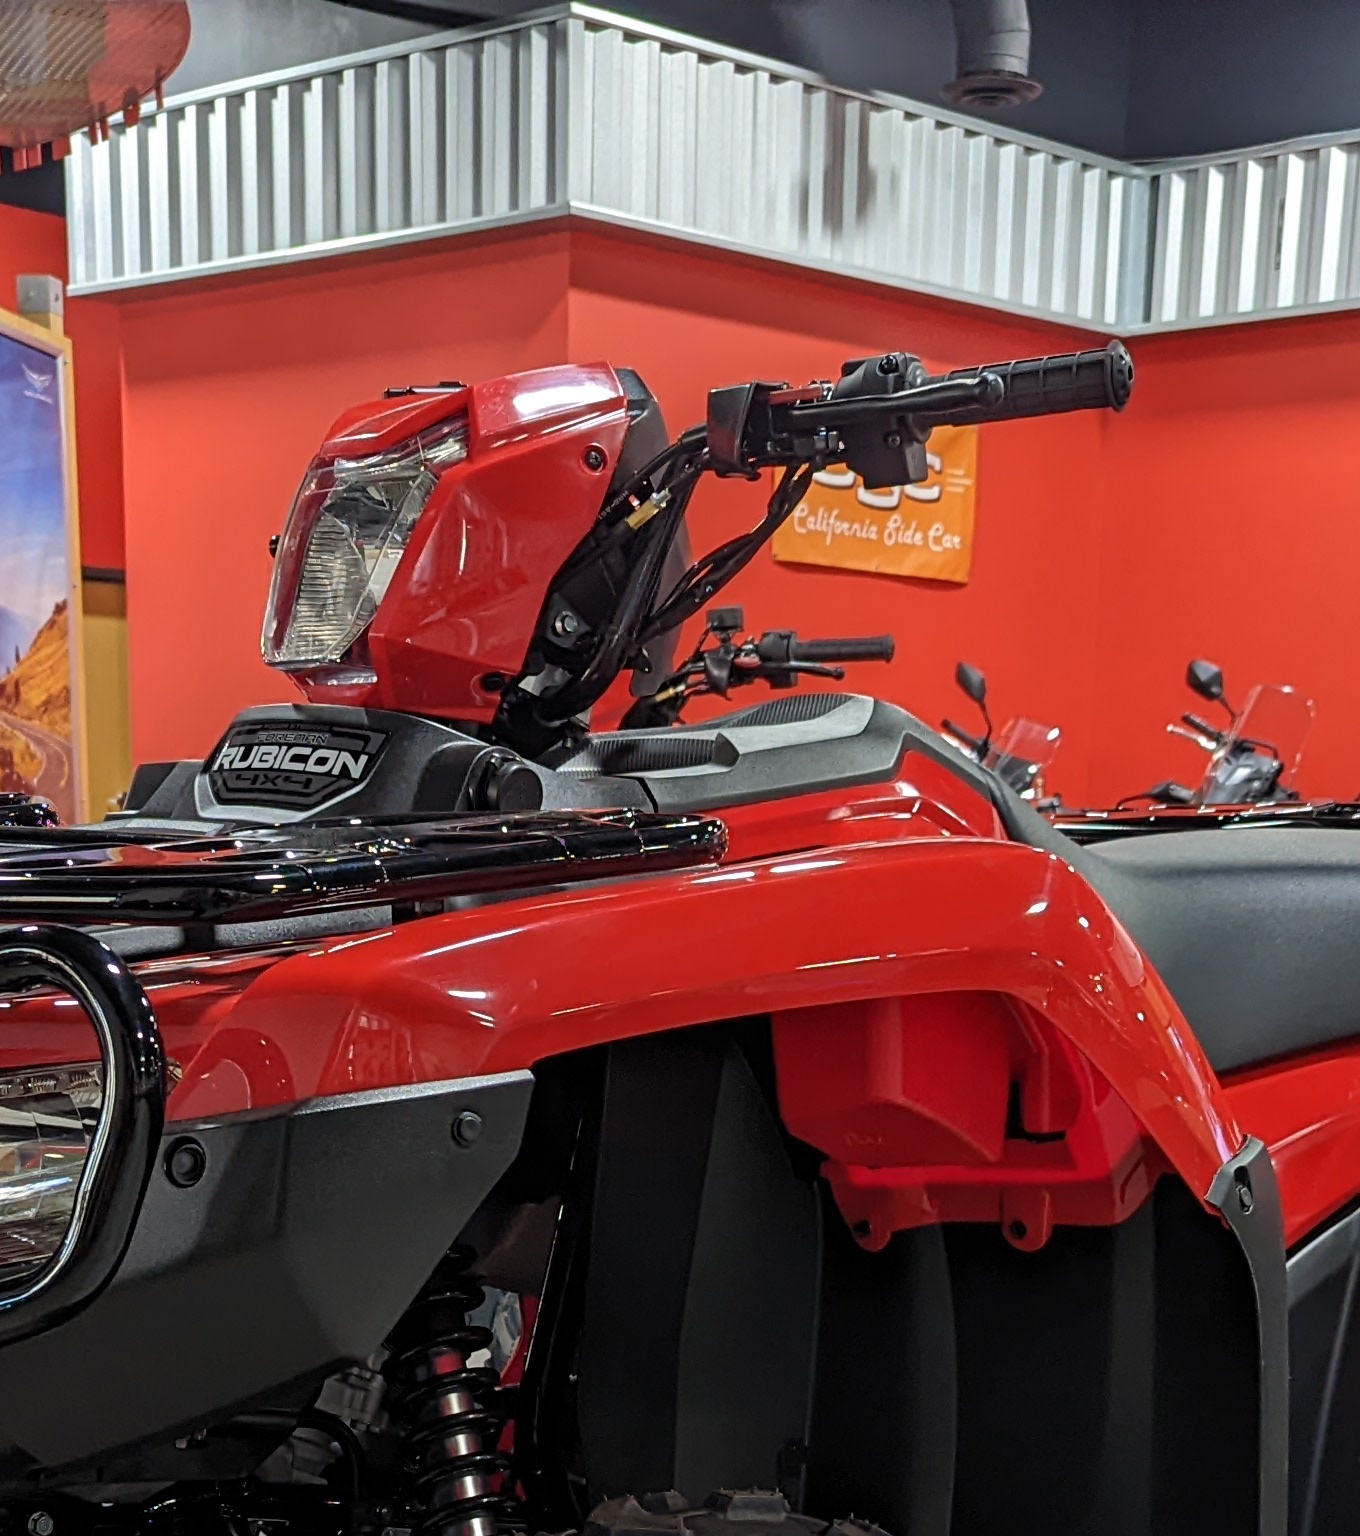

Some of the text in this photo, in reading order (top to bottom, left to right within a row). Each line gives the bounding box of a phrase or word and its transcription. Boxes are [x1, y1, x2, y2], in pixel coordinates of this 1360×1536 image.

[793, 503, 962, 552] California Side Car
[256, 732, 329, 744] FOREMAN
[213, 745, 370, 780] RUBICON
